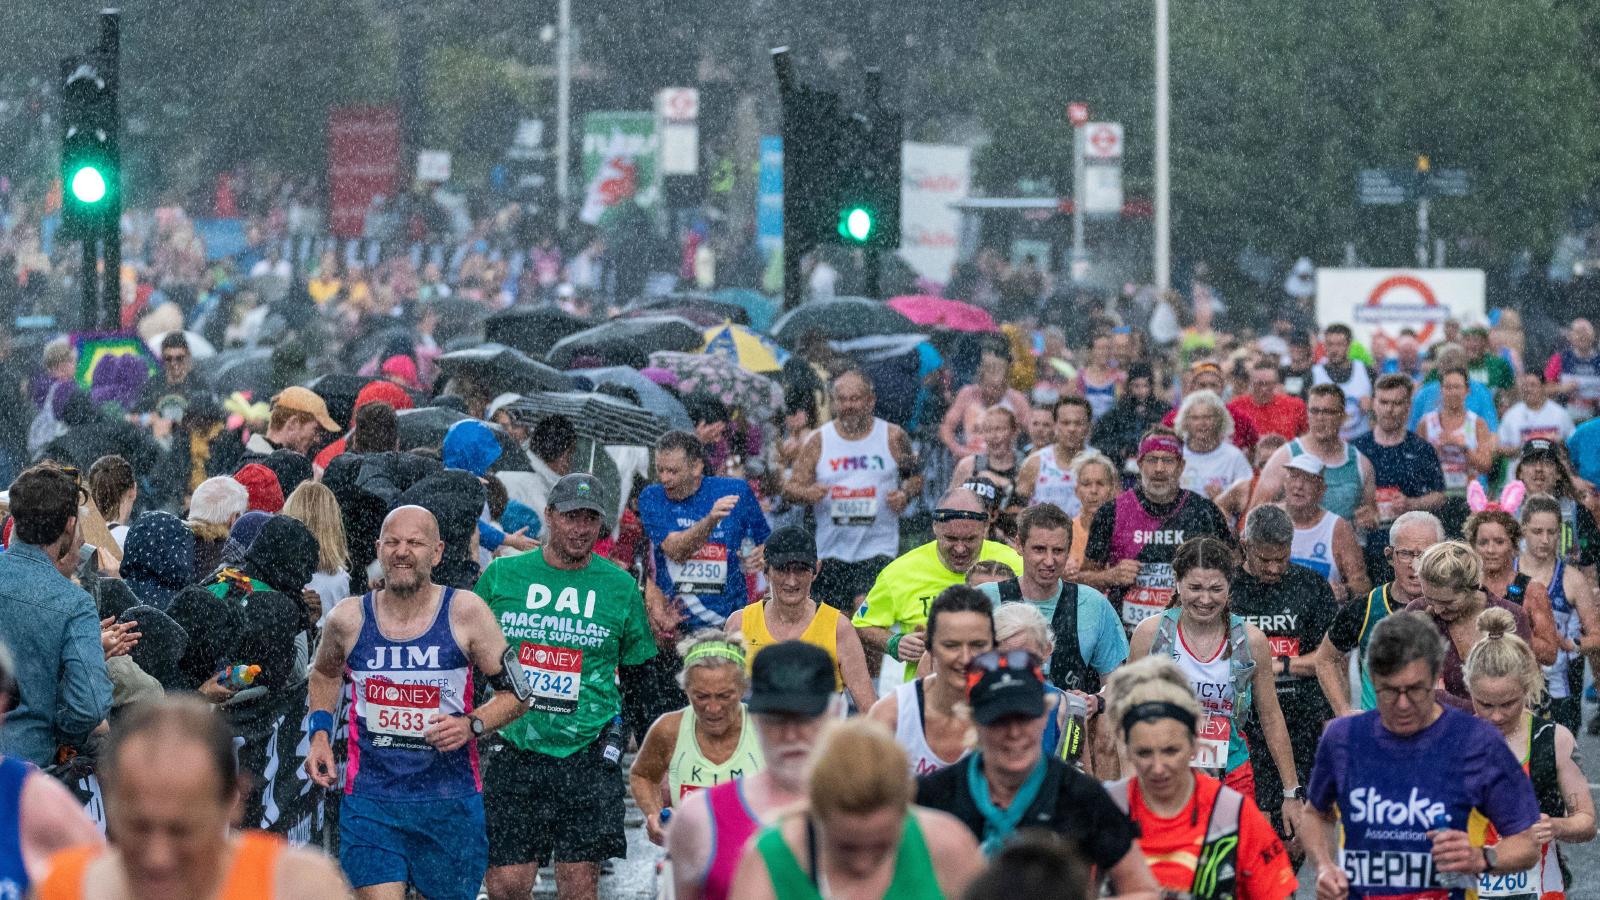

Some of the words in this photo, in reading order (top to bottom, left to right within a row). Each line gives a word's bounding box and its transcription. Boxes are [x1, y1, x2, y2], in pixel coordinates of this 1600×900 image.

[1133, 529, 1185, 545] SHREK
[680, 562, 721, 578] 22350
[1149, 576, 1175, 588] CANCE
[526, 583, 596, 619] DAI
[1127, 590, 1171, 602] MONE
[500, 611, 611, 638] MACMILLAN
[502, 626, 546, 640] CANCER
[548, 631, 604, 647] SUPPORT
[1269, 640, 1297, 653] NEY
[366, 645, 441, 670] JIM
[522, 645, 580, 668] MONEY
[368, 684, 436, 704] MONEY
[534, 702, 546, 711] new
[547, 703, 572, 714] balance
[378, 709, 425, 732] 5433
[392, 740, 406, 750] new
[406, 741, 433, 751] balance
[691, 765, 744, 786] KIM
[1349, 787, 1452, 829] Stroke
[1365, 828, 1427, 842] Association
[1479, 870, 1528, 892] 4260
